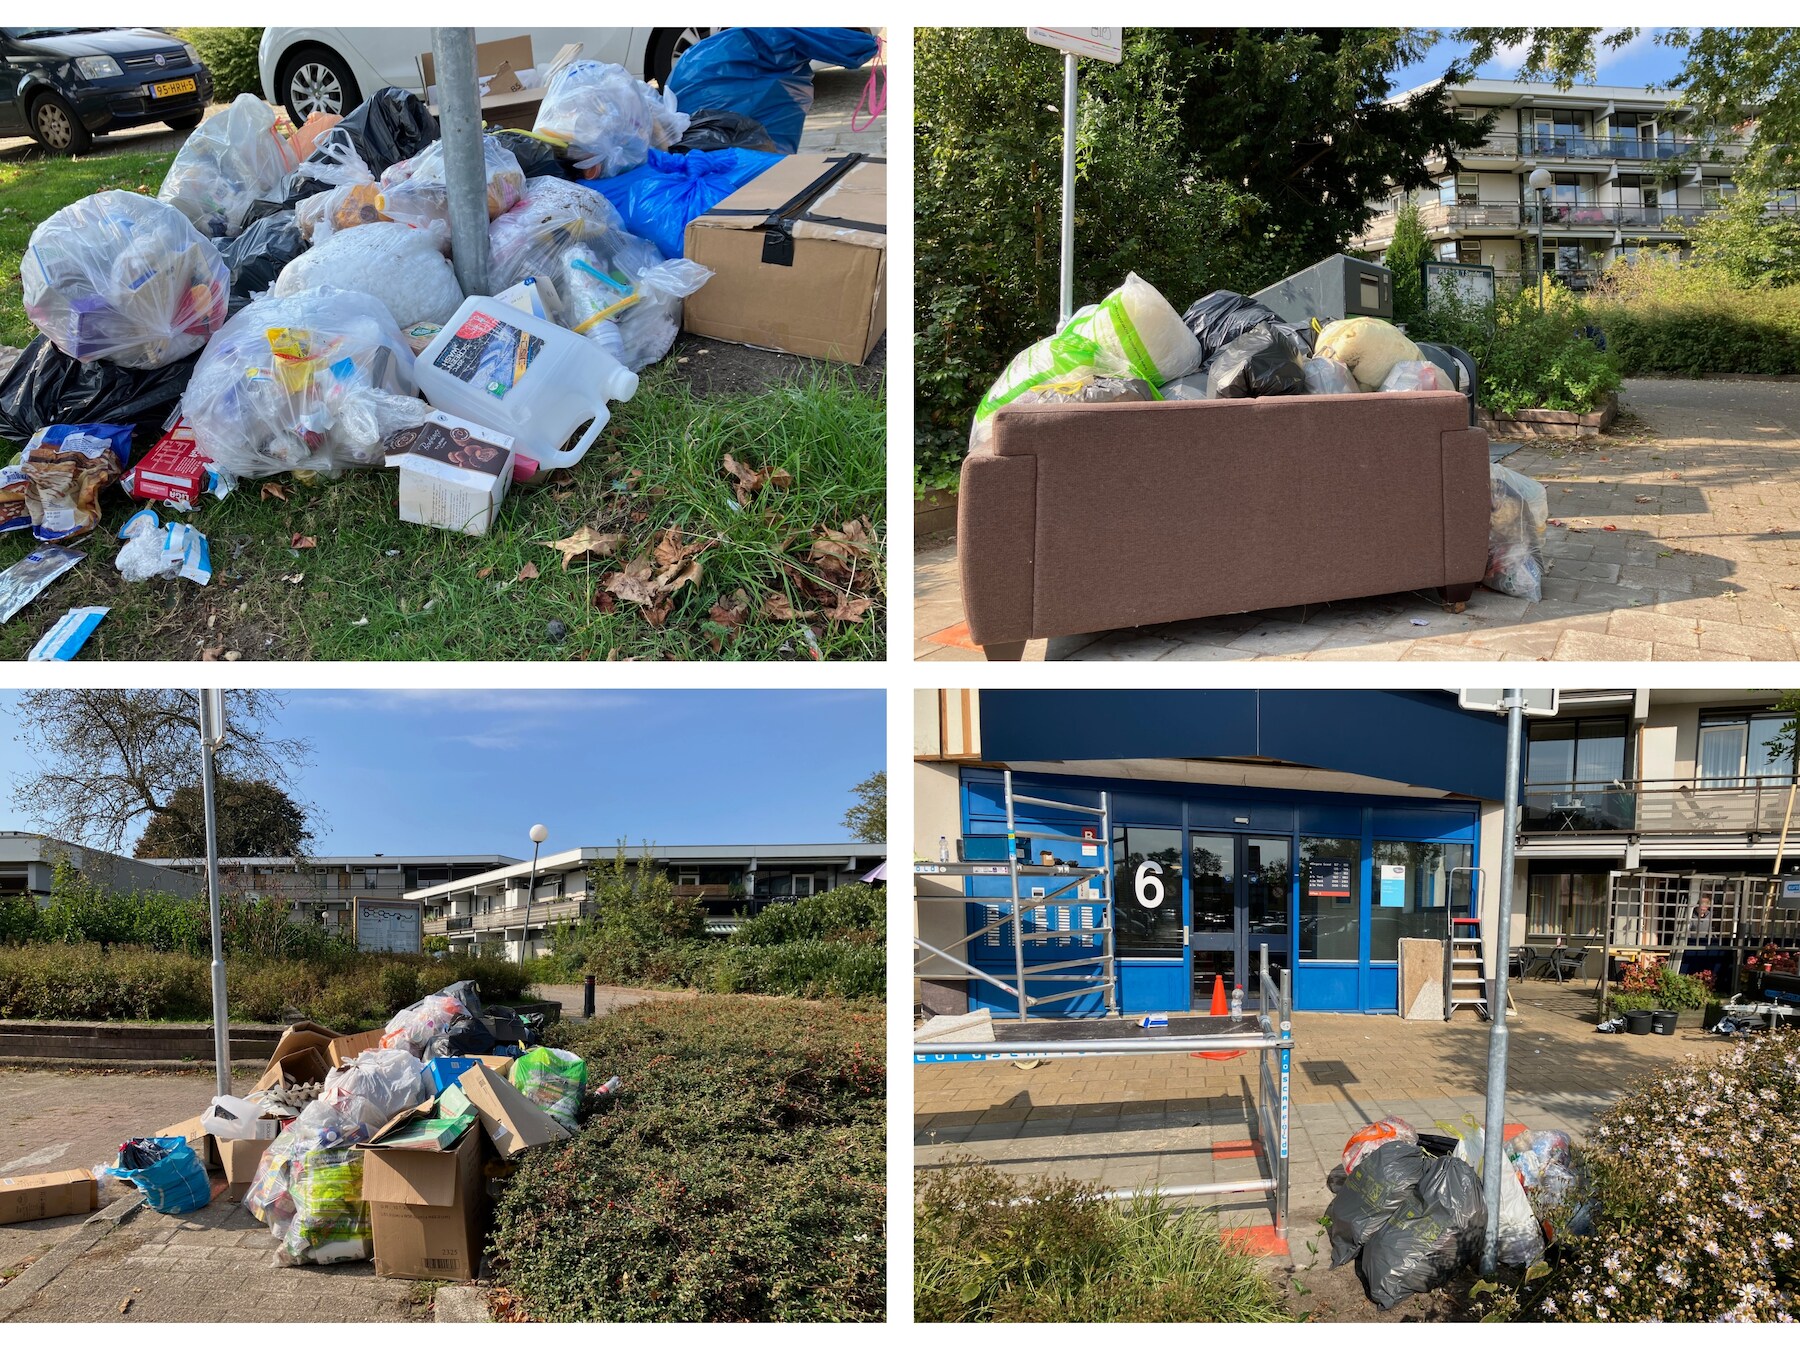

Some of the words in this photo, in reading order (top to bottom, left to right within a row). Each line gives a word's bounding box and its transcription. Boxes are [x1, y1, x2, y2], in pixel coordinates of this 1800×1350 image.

[156, 80, 194, 96] 95-HRH-5
[169, 489, 190, 501] LIGA
[1135, 860, 1165, 909] 6
